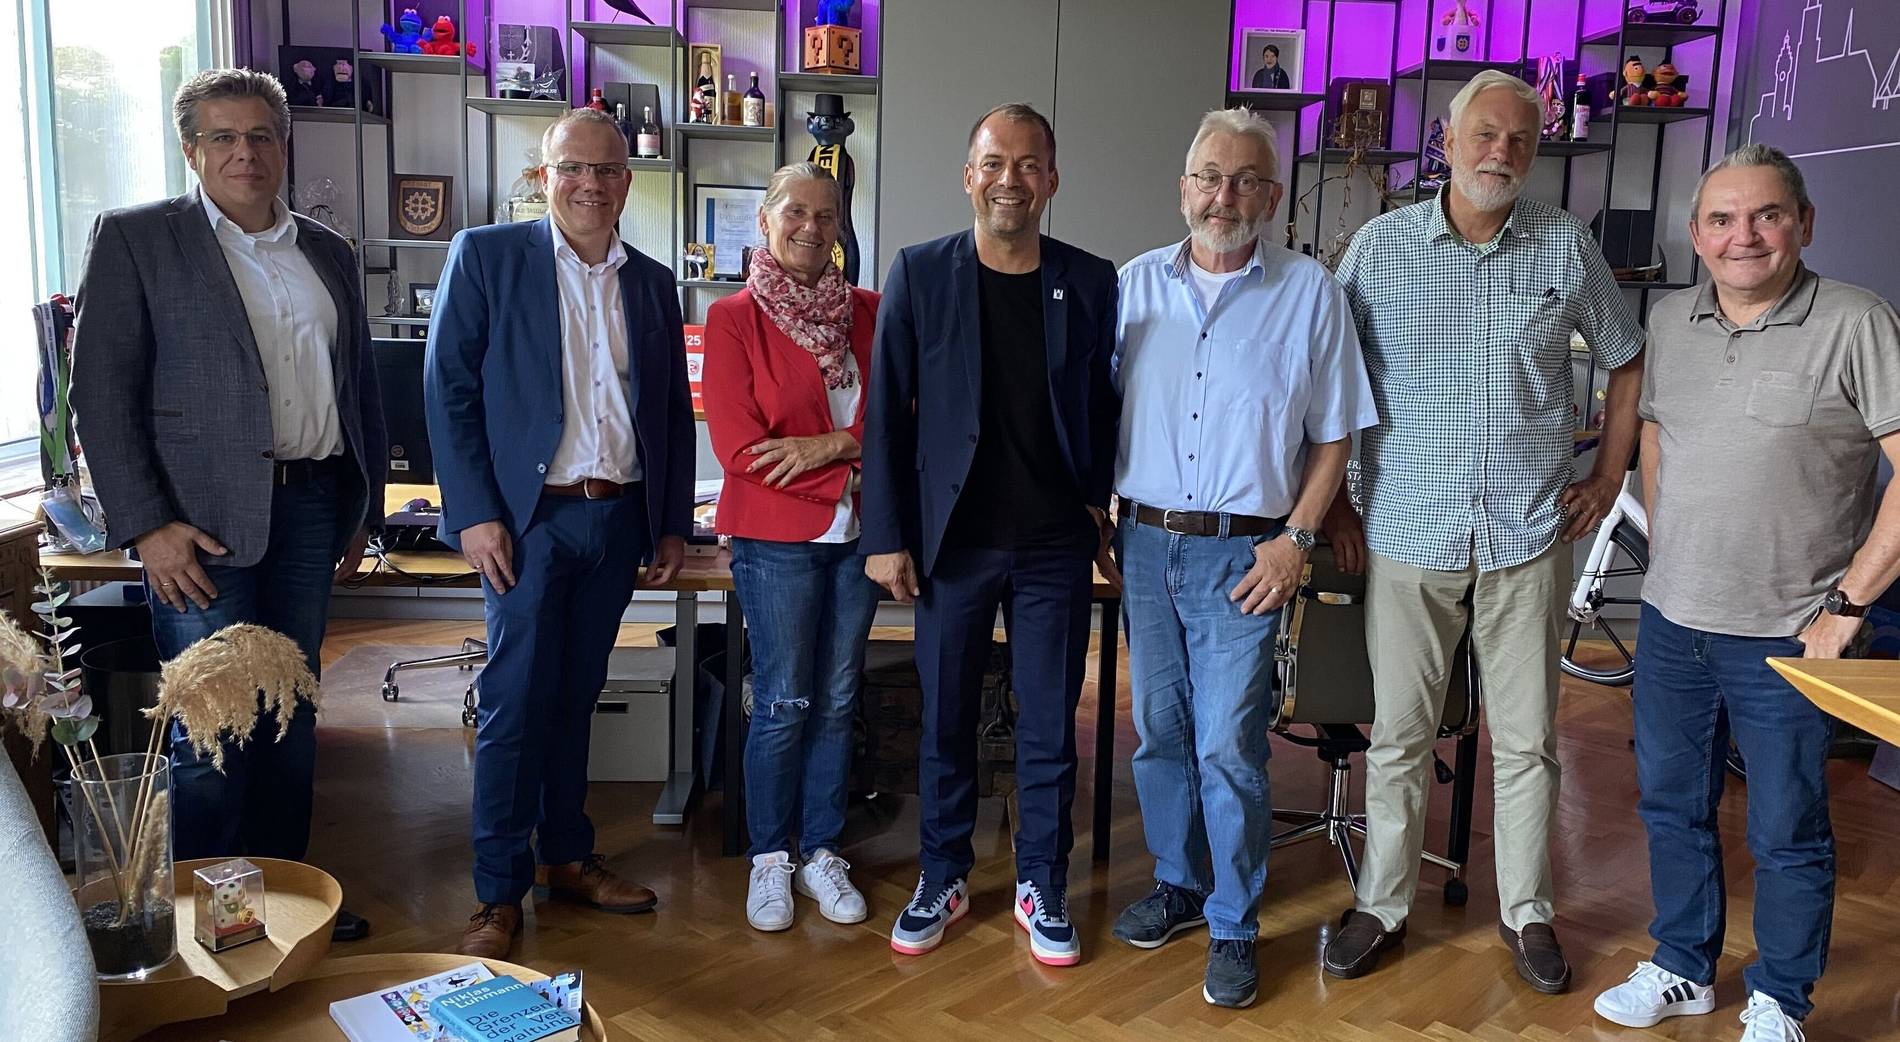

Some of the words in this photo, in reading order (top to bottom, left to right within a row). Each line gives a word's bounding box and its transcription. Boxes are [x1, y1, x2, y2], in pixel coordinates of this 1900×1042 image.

[685, 334, 702, 346] 25
[441, 986, 490, 1007] Niklas
[454, 983, 525, 1009] Luhmann
[466, 1010, 499, 1026] Die
[476, 1002, 552, 1032] Grenzen
[487, 1022, 519, 1040] der
[528, 1010, 562, 1023] Ver
